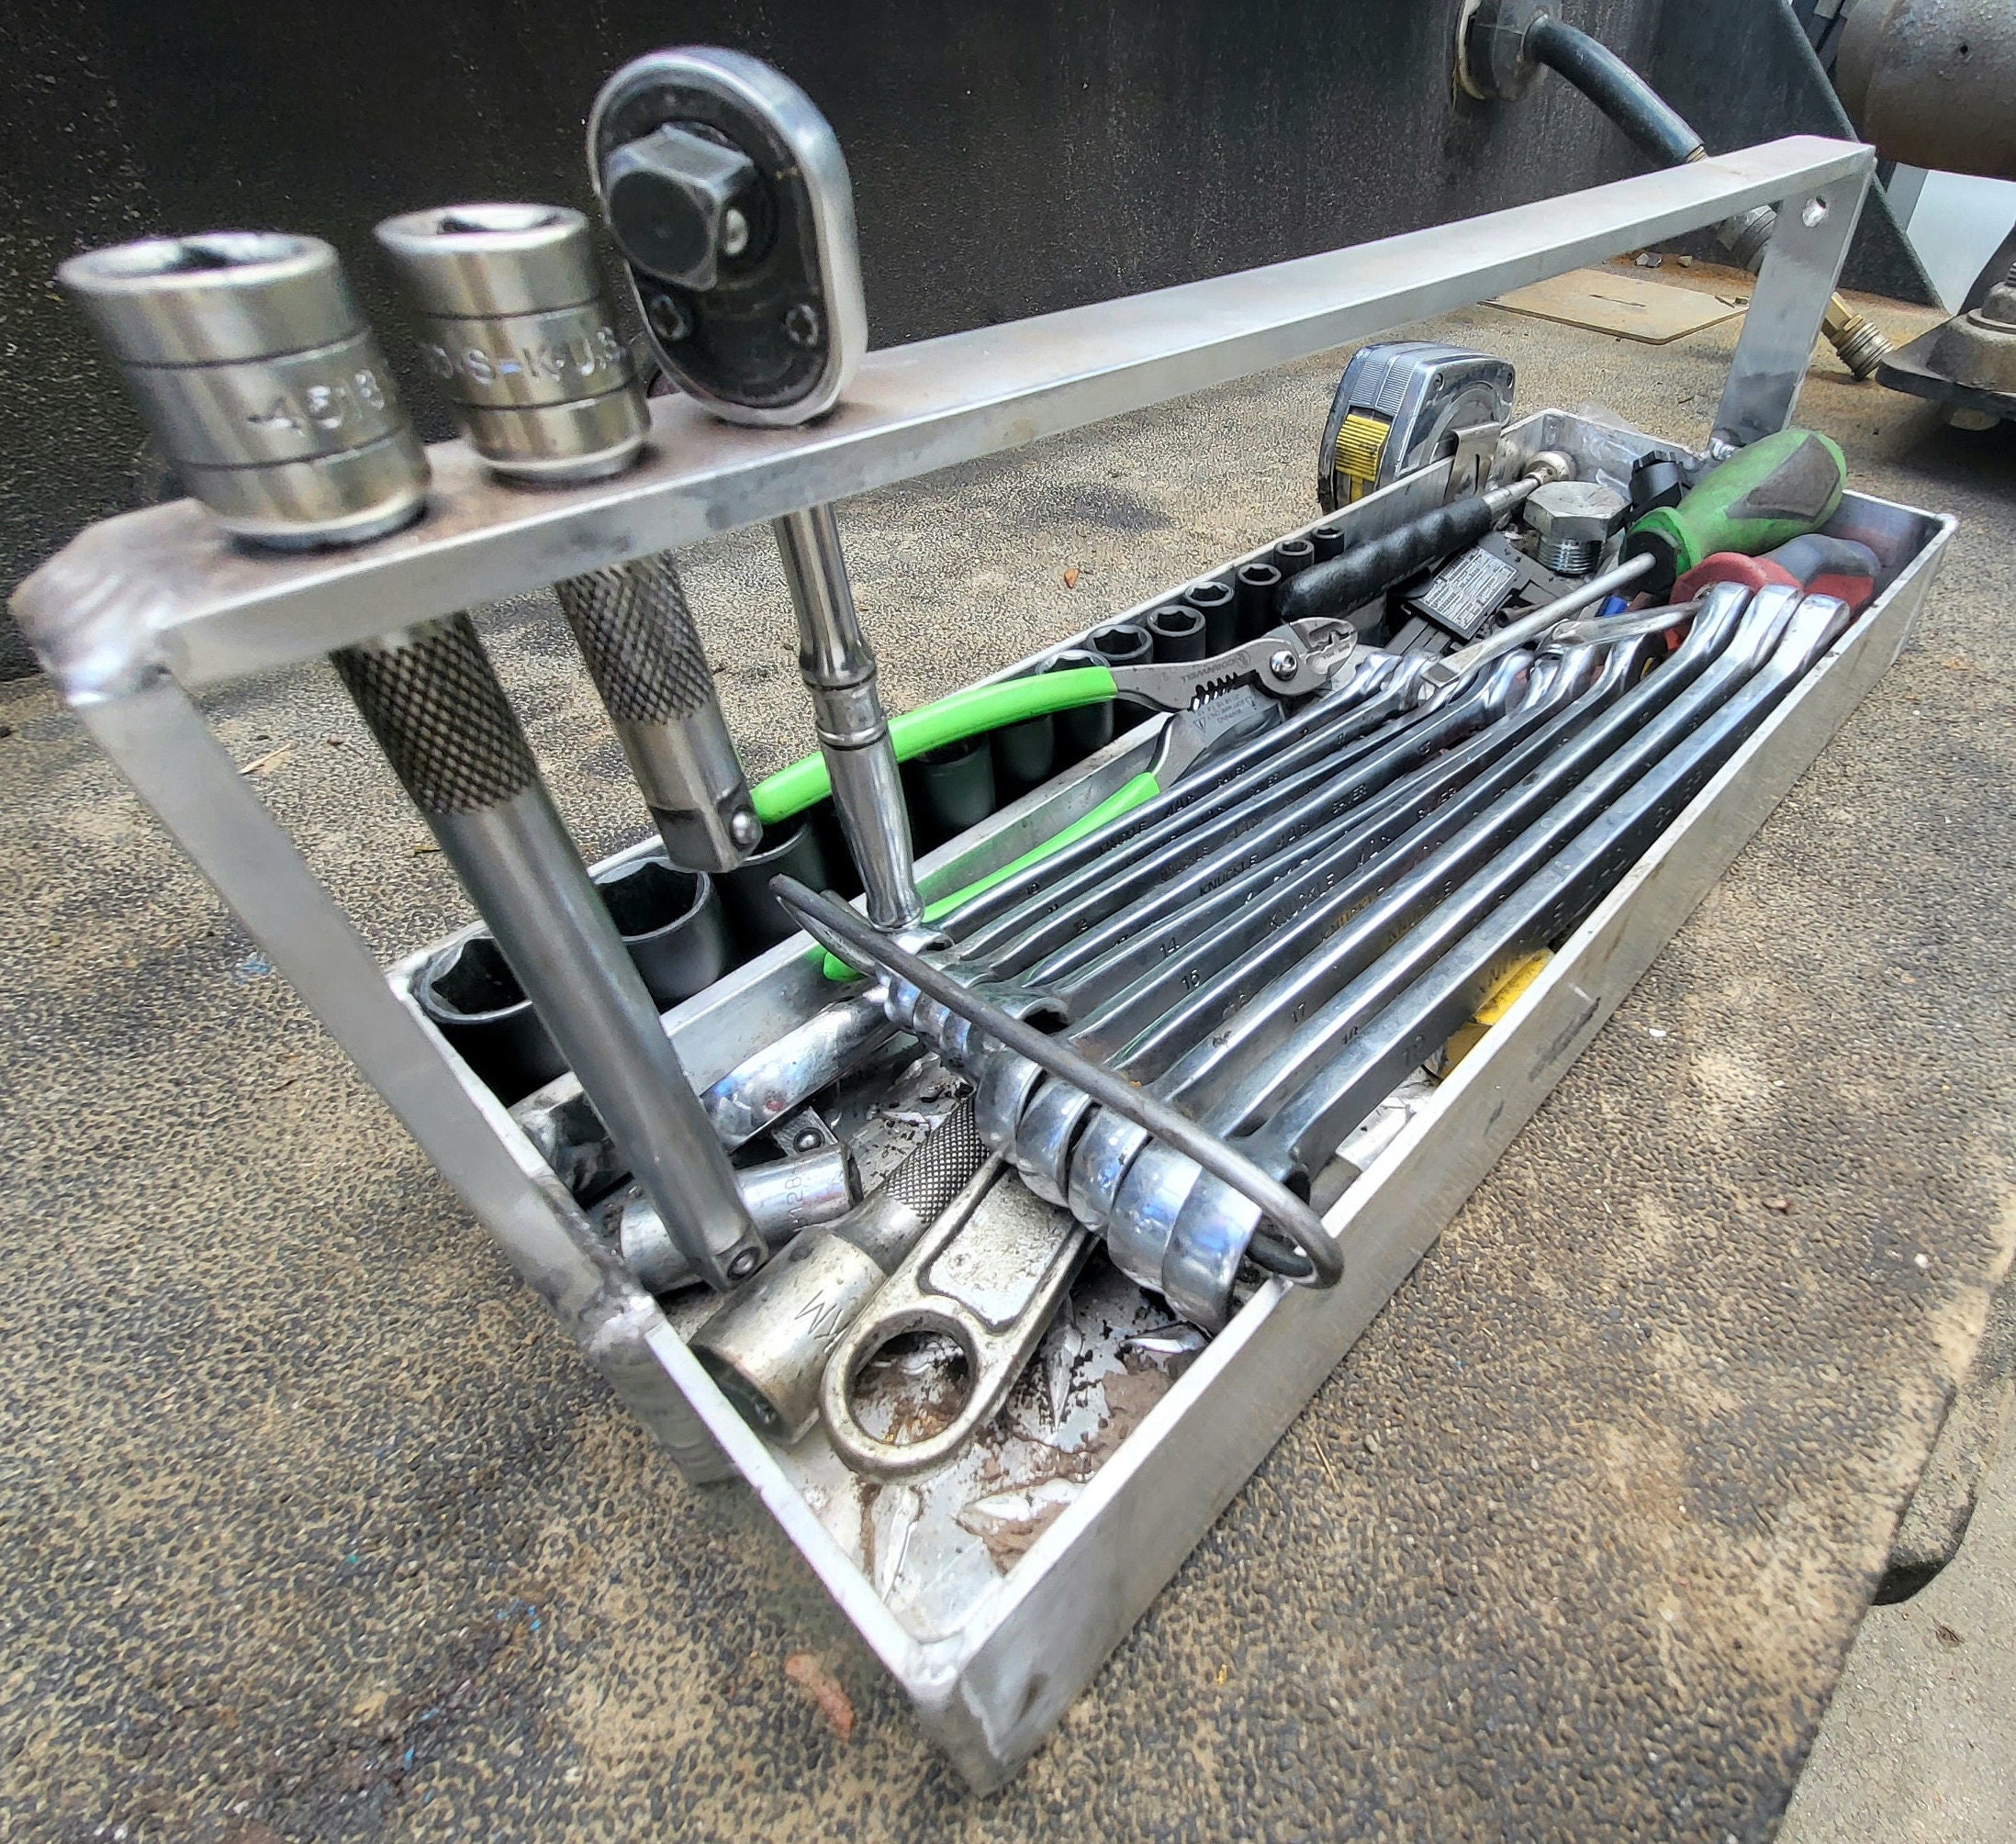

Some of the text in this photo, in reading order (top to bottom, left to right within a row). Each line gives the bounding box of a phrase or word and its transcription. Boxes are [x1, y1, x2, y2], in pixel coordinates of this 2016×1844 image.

[1159, 937, 1181, 959] 14
[1181, 969, 1201, 992] 15
[1291, 1002, 1307, 1023] 17
